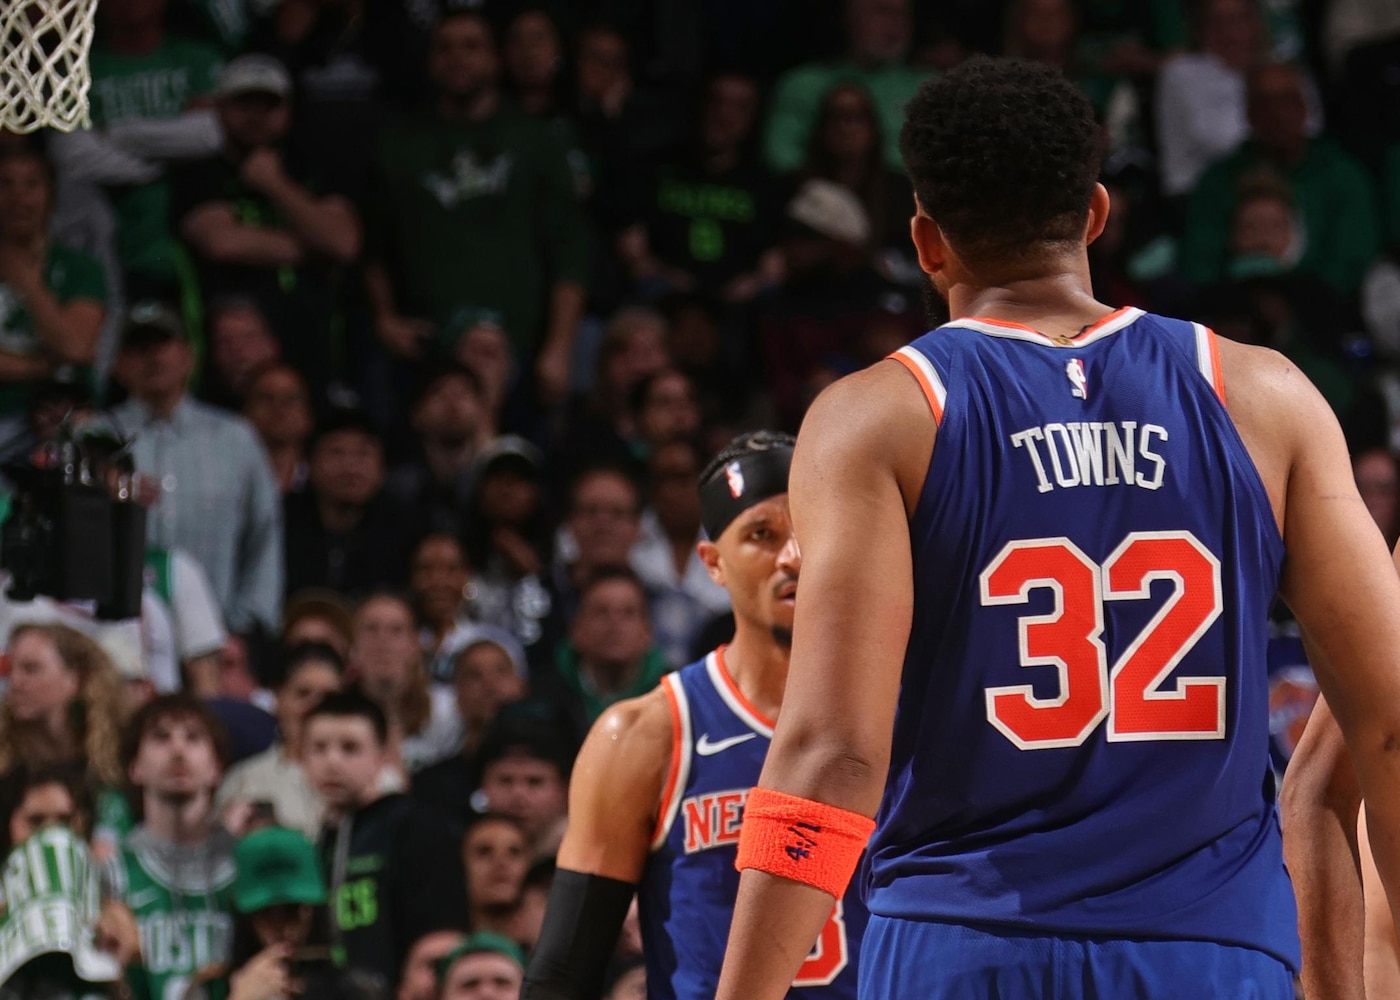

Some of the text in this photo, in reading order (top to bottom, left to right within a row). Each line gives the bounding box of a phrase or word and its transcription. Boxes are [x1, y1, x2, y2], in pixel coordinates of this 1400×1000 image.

[1010, 421, 1169, 493] TOWNS
[979, 530, 1226, 750] 32
[682, 787, 748, 854] NE
